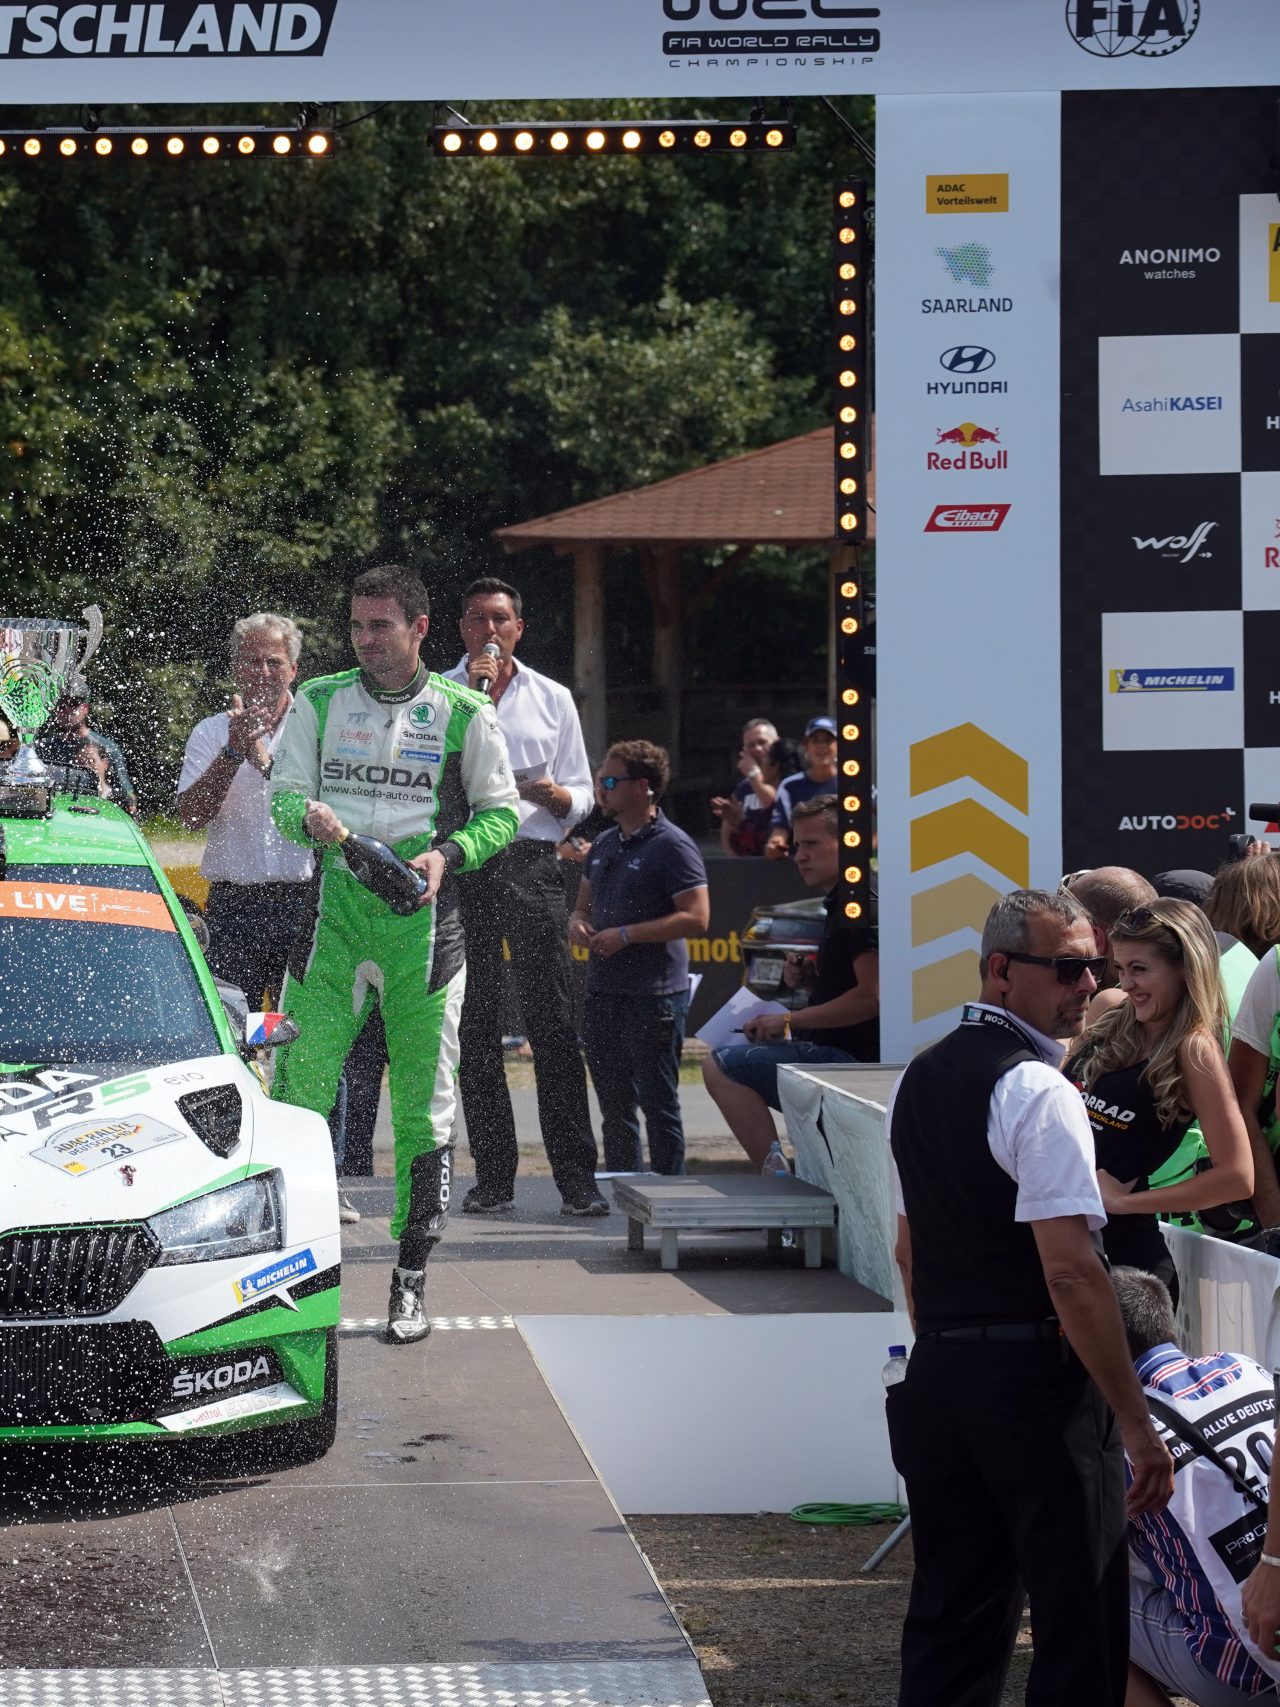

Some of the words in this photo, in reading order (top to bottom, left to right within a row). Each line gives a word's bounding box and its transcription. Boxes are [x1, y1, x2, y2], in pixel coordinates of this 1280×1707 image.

[668, 37, 702, 48] FIA
[708, 36, 789, 48] WORLD
[795, 35, 874, 46] RALLY
[668, 57, 874, 68] CHAMPIONSHIP
[936, 183, 966, 193] ADAC
[936, 195, 998, 206] Vorteilswelt
[1119, 247, 1221, 265] ANONIMO
[1143, 268, 1196, 279] watches
[921, 298, 1014, 314] SAARLAND
[926, 381, 1009, 395] HYUNDAI
[927, 451, 966, 470] Red
[970, 450, 1008, 470] Bull
[934, 508, 999, 528] Eibach
[1143, 674, 1225, 686] MICHELIN
[402, 730, 438, 742] ŠKODA
[322, 759, 433, 791] ŠKODA
[322, 785, 432, 804] www.skoda-auto.com
[15, 892, 89, 913] LIVE
[163, 1072, 205, 1086] evo
[101, 1143, 134, 1159] 23
[256, 1257, 308, 1289] MICHELIN
[172, 1356, 271, 1397] ŠKODA
[1202, 1410, 1239, 1440] ALLYE
